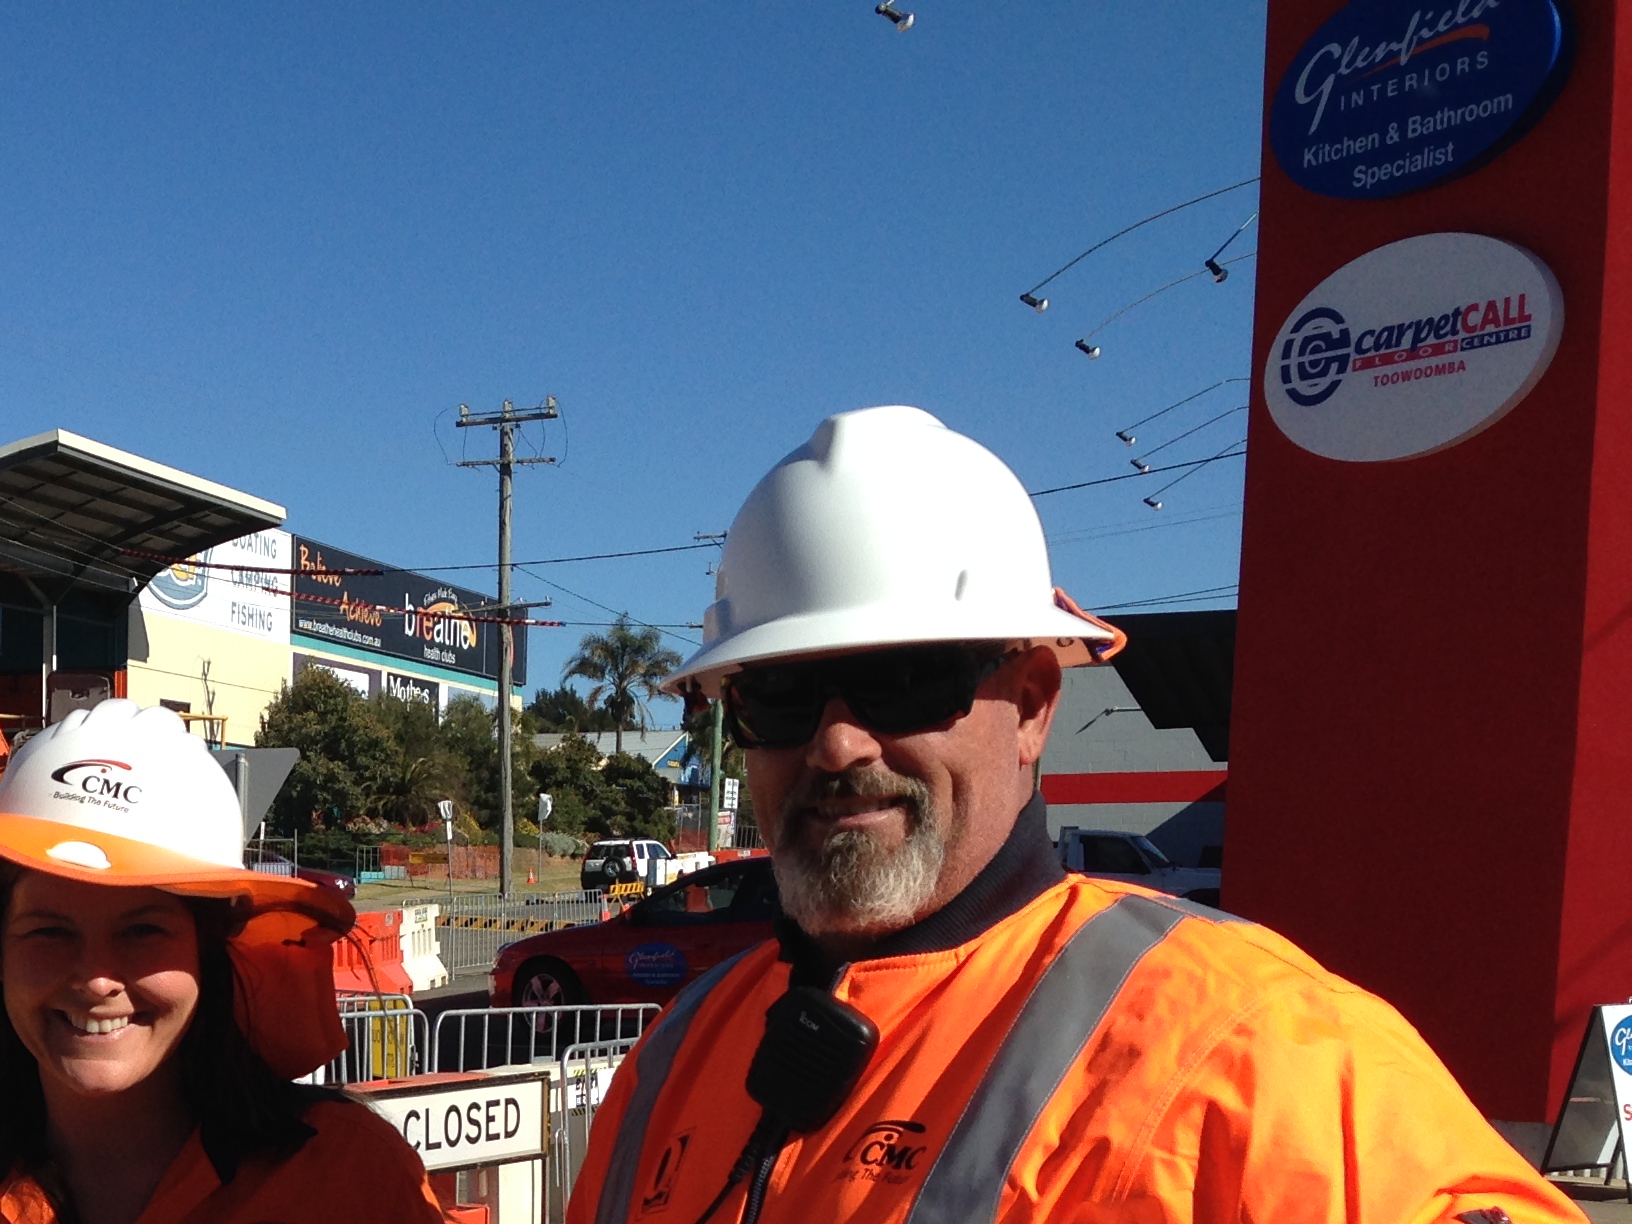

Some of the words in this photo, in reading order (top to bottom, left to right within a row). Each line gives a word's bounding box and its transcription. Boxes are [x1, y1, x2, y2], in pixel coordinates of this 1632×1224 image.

[1340, 51, 1489, 111] INTERIORS
[1303, 132, 1380, 169] Kitchen
[1385, 122, 1400, 145] &
[1407, 93, 1513, 139] Bathroom
[1352, 141, 1455, 189] Specialist
[1461, 324, 1531, 350] CENTRE
[1373, 359, 1467, 387] TOOWOOMBA
[230, 601, 273, 632] FISHING
[405, 592, 471, 650] breathe
[424, 644, 441, 661] health
[53, 791, 87, 804] Building
[88, 796, 102, 806] The
[103, 801, 130, 813] Future
[82, 775, 143, 804] CMC
[403, 1097, 521, 1151] CLOSED
[859, 1141, 928, 1170] CMC
